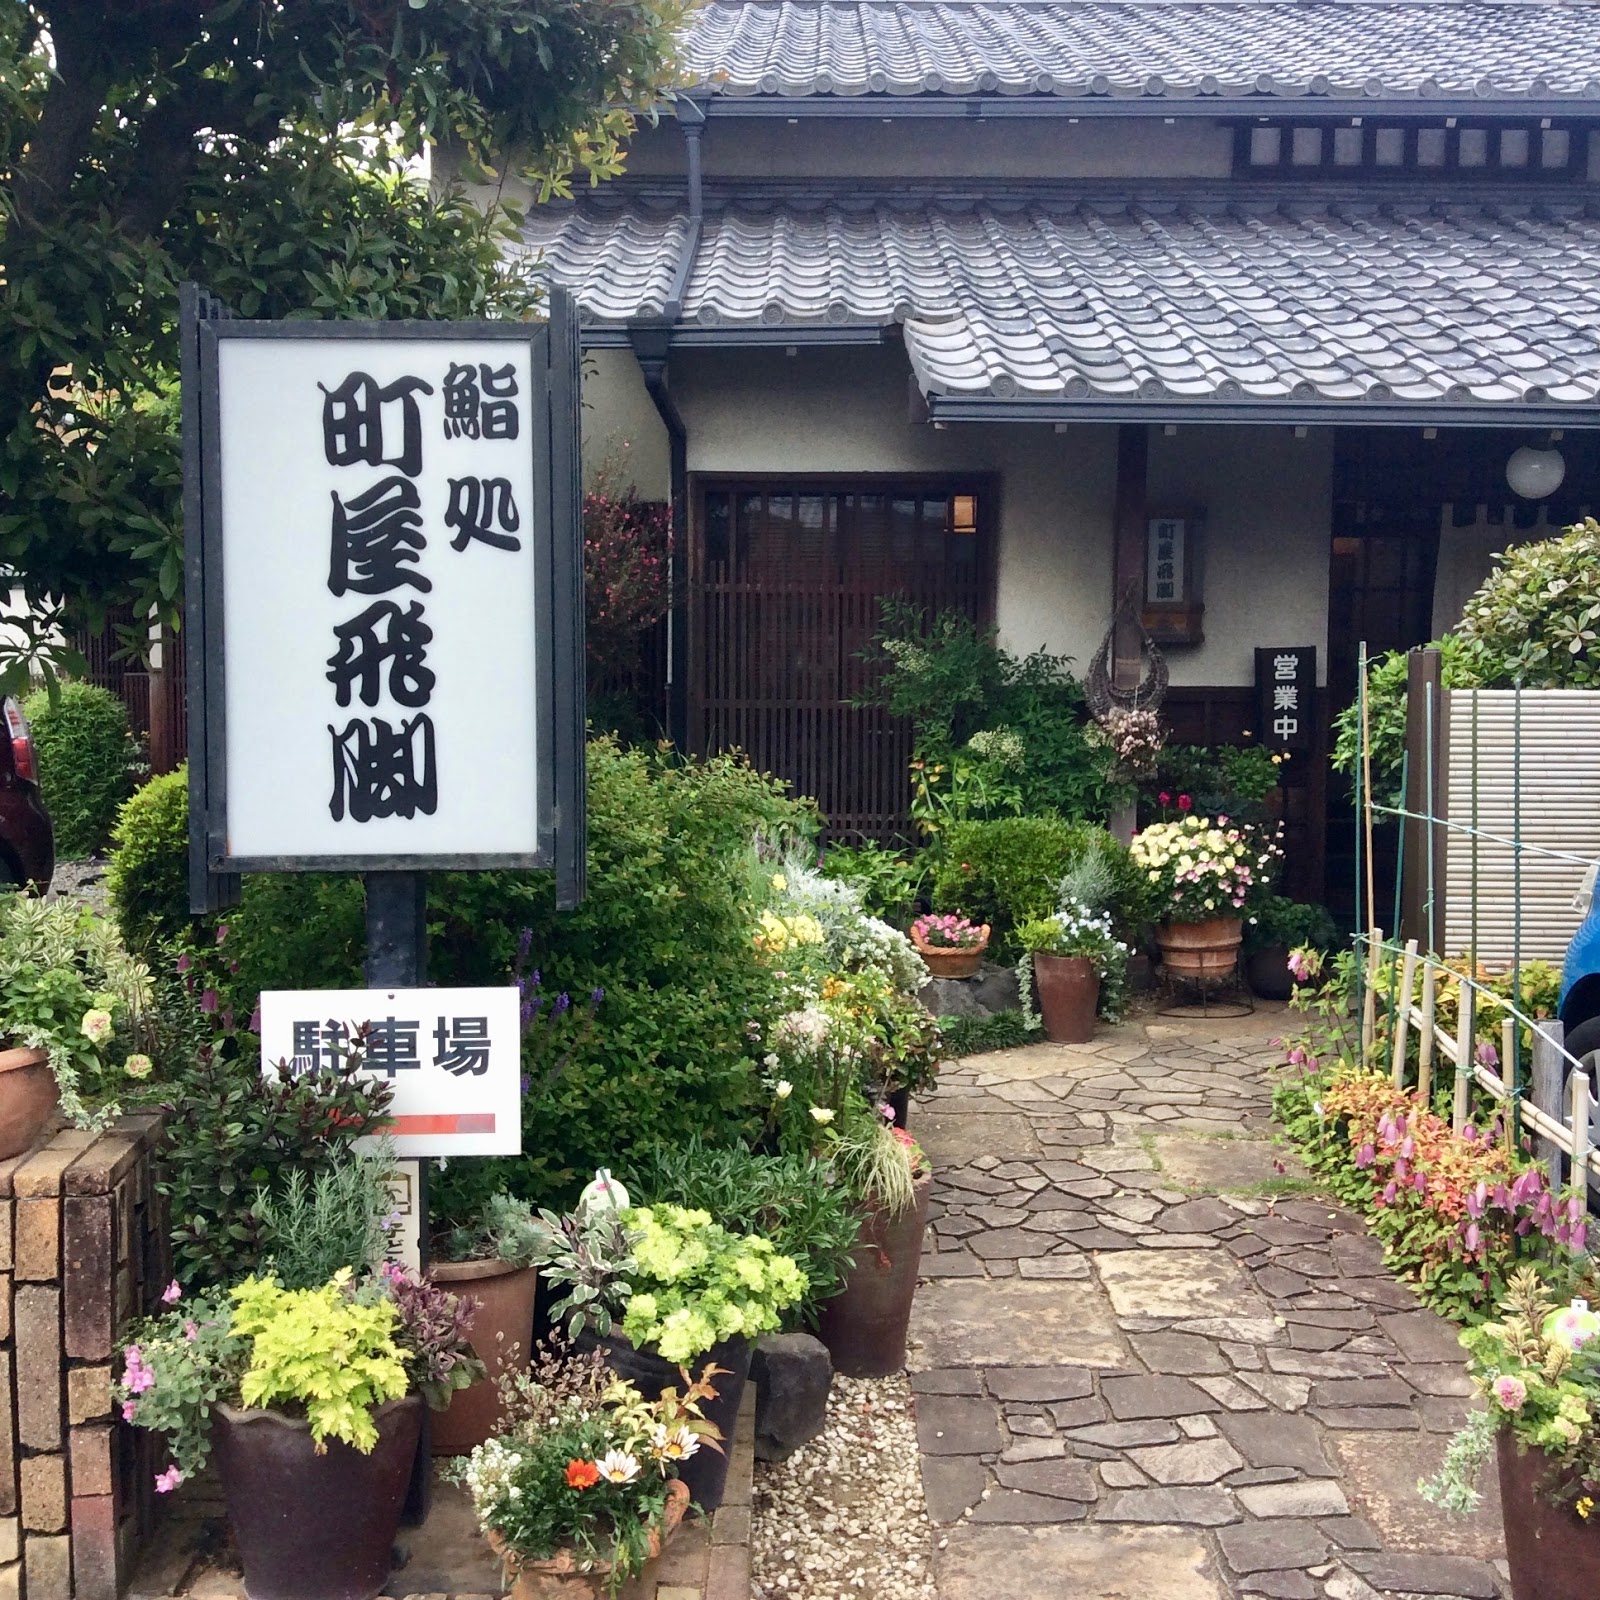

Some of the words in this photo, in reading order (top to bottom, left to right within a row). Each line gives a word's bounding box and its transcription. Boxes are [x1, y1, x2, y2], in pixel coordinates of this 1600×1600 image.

[441, 362, 521, 552] 鮨処
[317, 371, 438, 823] 町屋飛脚
[1273, 654, 1298, 741] 営業中
[292, 1016, 492, 1078] 駐車場
